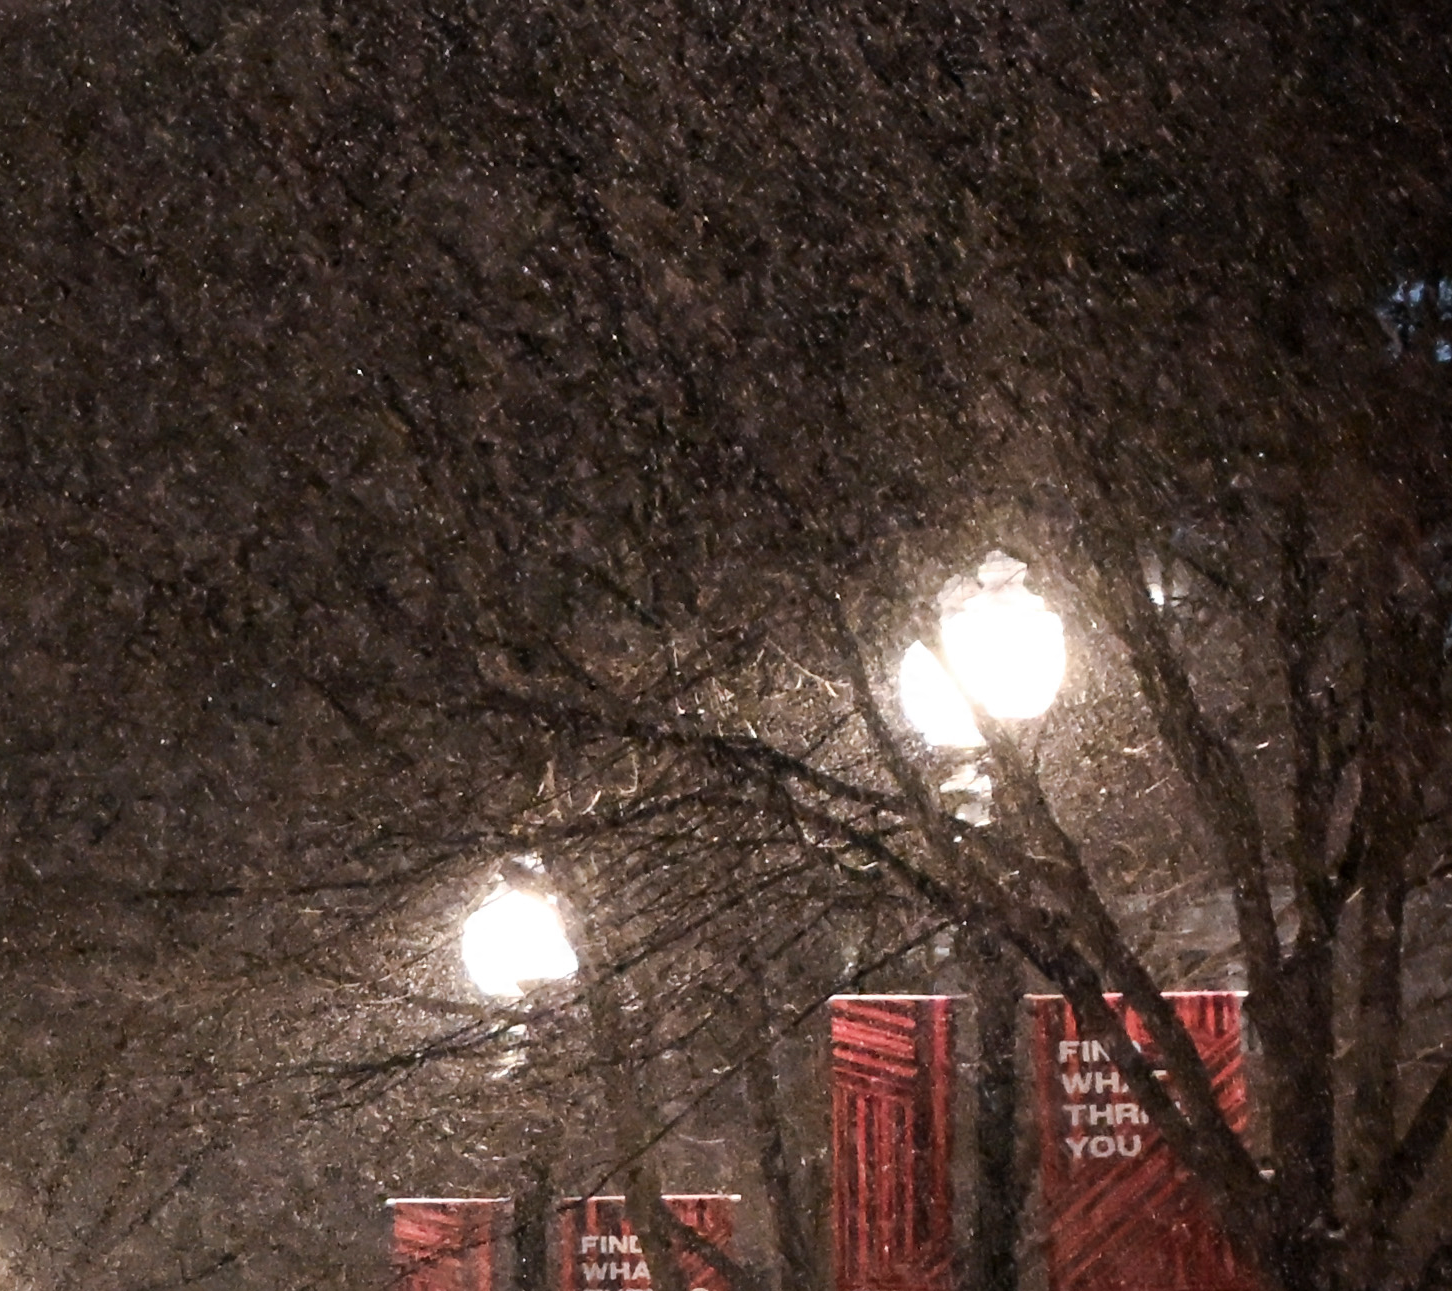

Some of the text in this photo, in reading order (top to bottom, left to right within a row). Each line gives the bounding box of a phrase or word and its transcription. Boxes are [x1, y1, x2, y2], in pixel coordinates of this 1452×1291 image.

[1059, 1039, 1142, 1063] FIN
[1065, 1134, 1142, 1159] YOU
[582, 1261, 652, 1281] WHA
